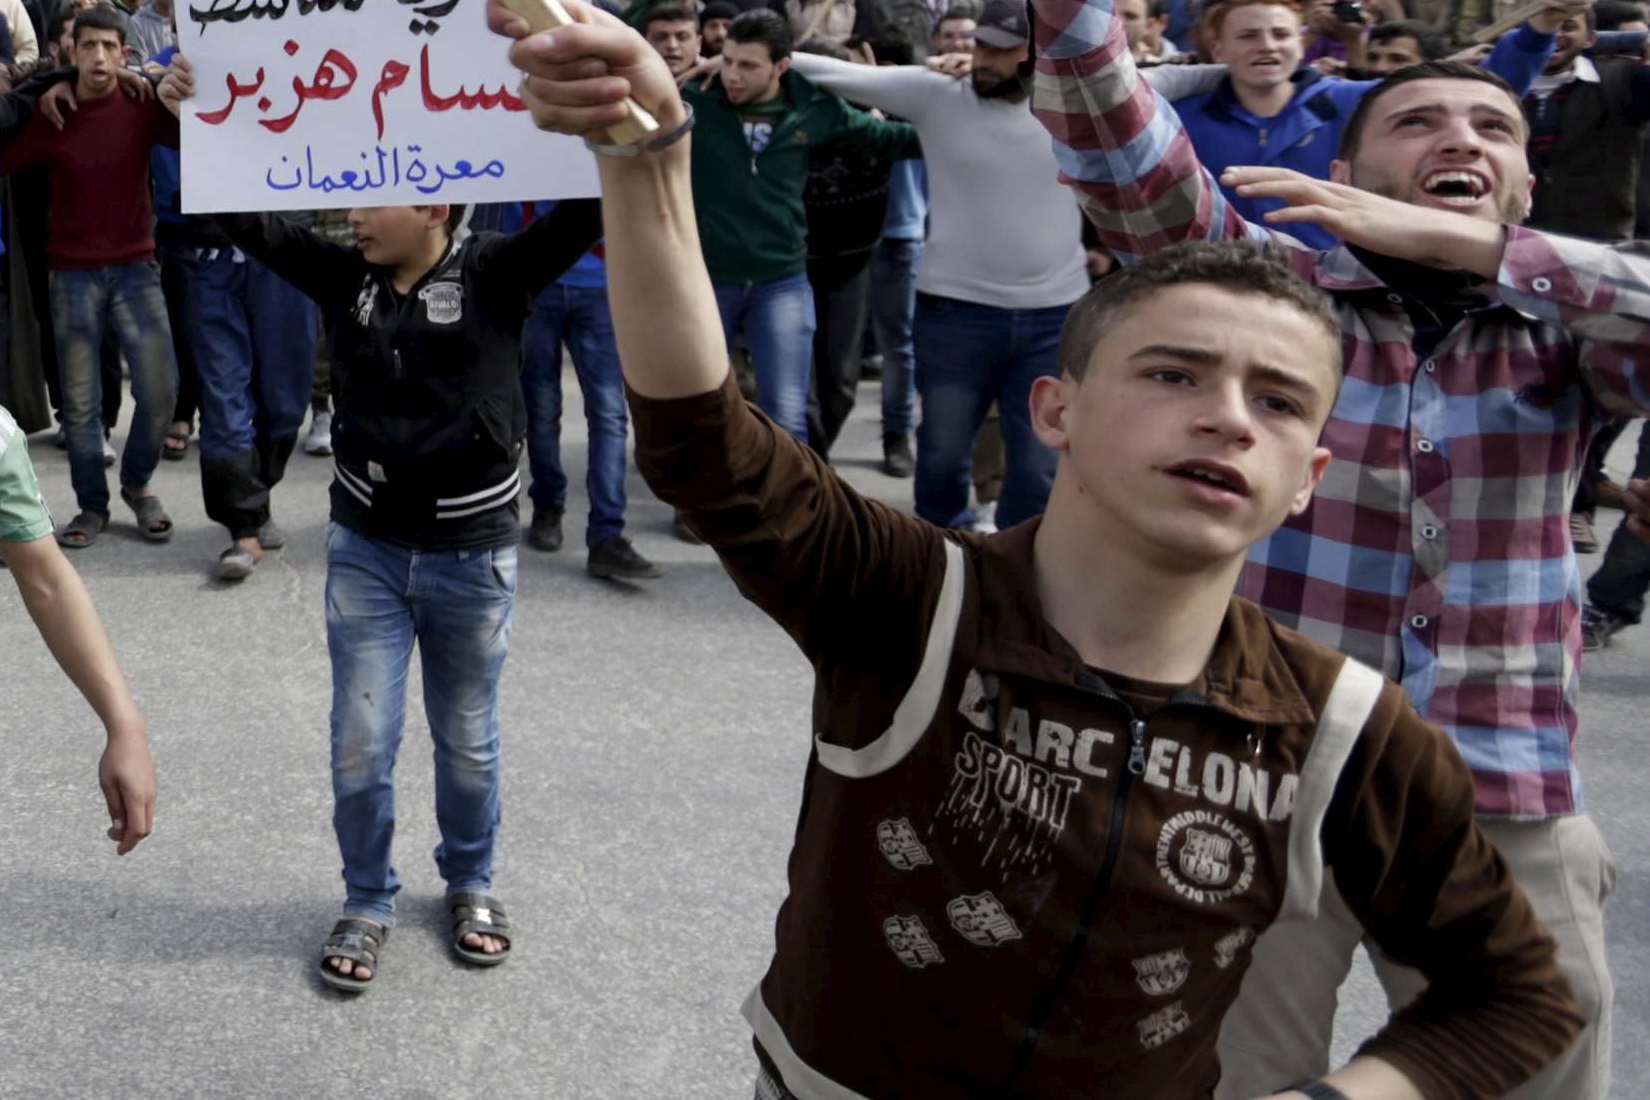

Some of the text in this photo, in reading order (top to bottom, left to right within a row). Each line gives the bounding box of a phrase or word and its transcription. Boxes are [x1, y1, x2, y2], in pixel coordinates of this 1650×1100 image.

[195, 39, 531, 143] سام هزبر
[266, 144, 506, 194] معرة النعمان
[954, 731, 1082, 830] SPORT
